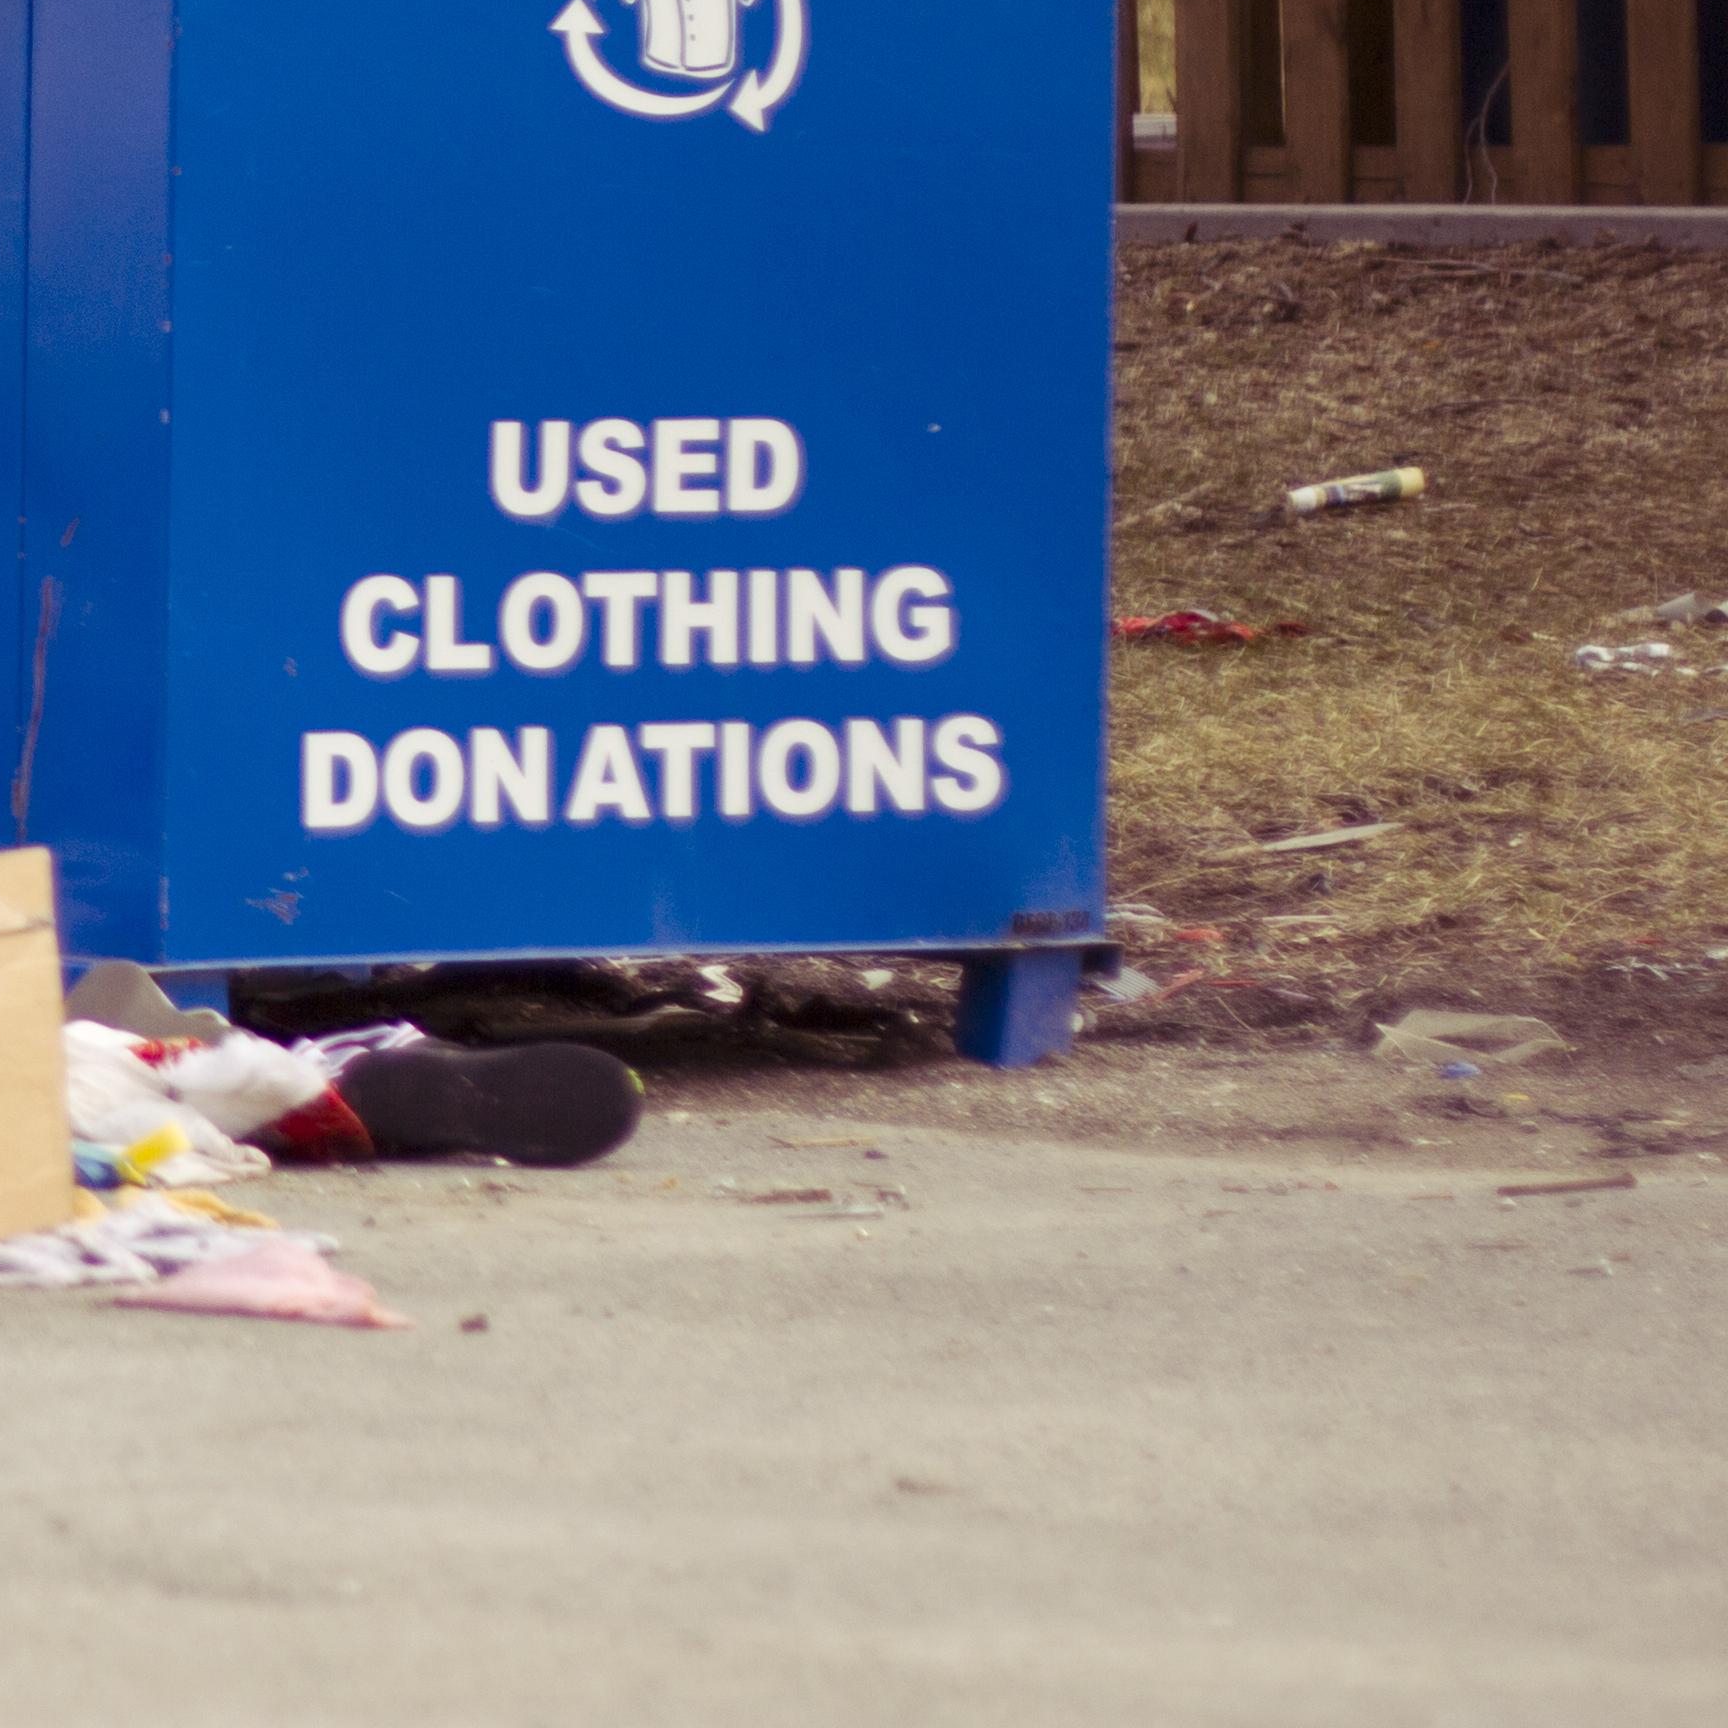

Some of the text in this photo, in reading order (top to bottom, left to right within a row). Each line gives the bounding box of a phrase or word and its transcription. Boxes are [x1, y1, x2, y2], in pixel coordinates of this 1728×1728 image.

[490, 417, 801, 516] USED
[342, 566, 952, 673] CLOTHING
[302, 714, 1003, 829] DONATIONS
